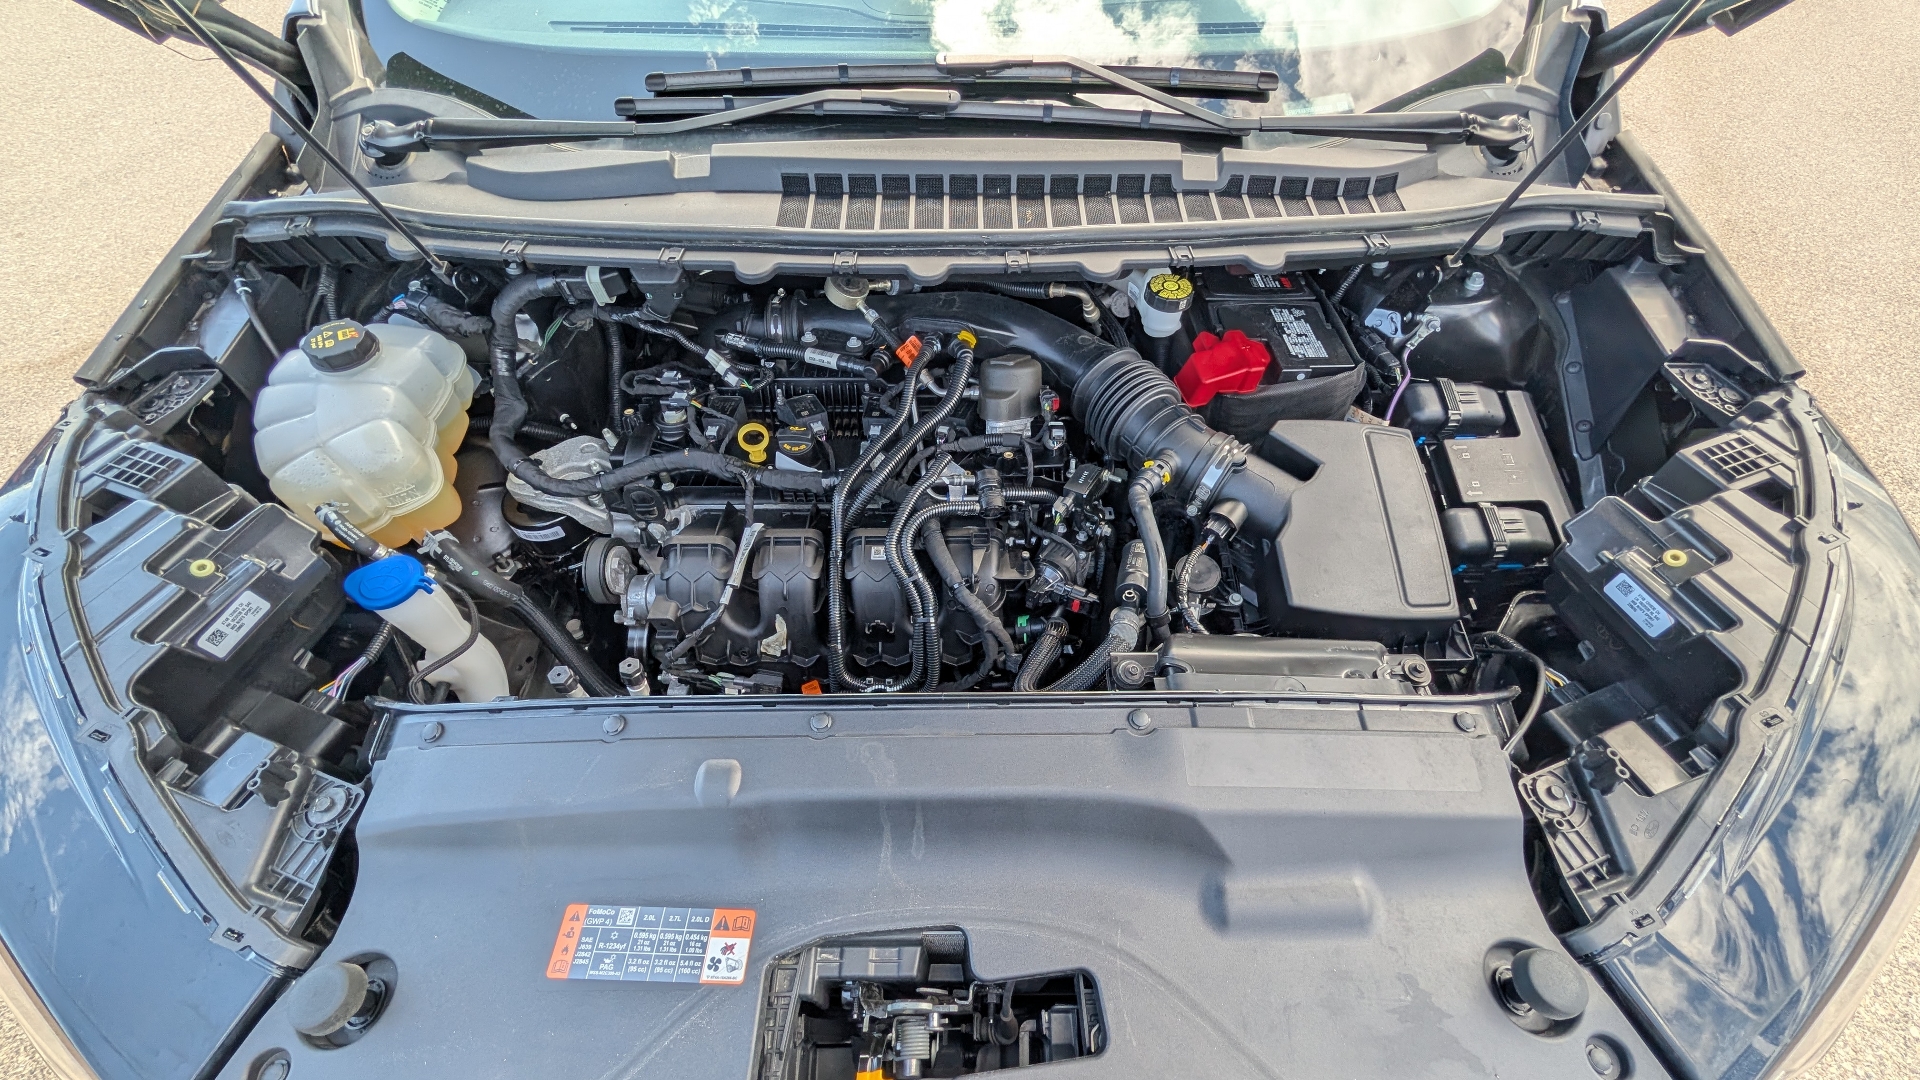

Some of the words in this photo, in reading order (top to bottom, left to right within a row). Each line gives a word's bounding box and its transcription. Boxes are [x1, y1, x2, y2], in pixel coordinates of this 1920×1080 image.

[584, 917, 604, 925] (GWP
[649, 933, 657, 941] kg
[674, 934, 683, 942] kg
[700, 934, 708, 942] kg
[598, 942, 627, 951] R-1234yf
[664, 967, 674, 975] cc)
